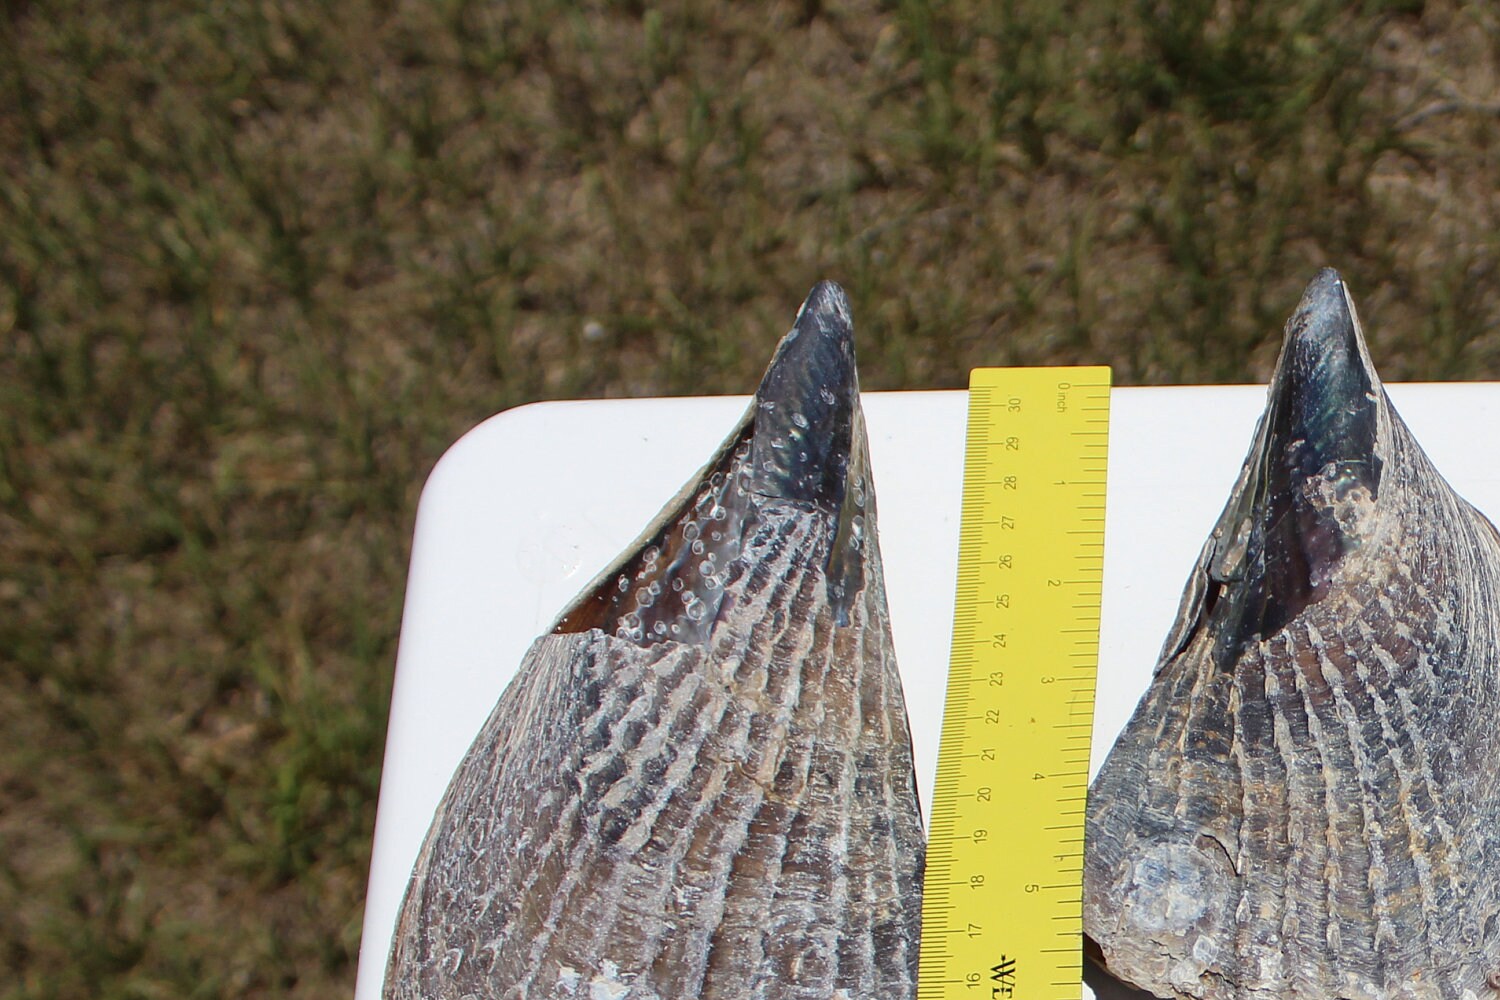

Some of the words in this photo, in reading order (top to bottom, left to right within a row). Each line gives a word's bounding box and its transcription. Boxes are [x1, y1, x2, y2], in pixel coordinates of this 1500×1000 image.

[1008, 398, 1021, 412] 30
[1057, 392, 1069, 413] inch
[1006, 436, 1019, 451] 29
[1004, 475, 1017, 490] 28
[1001, 516, 1014, 530] 27
[999, 554, 1012, 569] 26
[1048, 579, 1061, 587] 2
[996, 594, 1010, 609] 25
[993, 633, 1006, 649] 24
[989, 671, 1003, 686] 23
[1041, 676, 1055, 684] 3
[985, 709, 999, 724] 22
[981, 749, 995, 761] 21
[1032, 773, 1045, 781] 4
[977, 787, 991, 802] 20
[973, 829, 988, 844] 19
[970, 874, 985, 889] 18
[1024, 884, 1039, 893] 5
[968, 923, 982, 938] 17
[966, 972, 981, 989] 16
